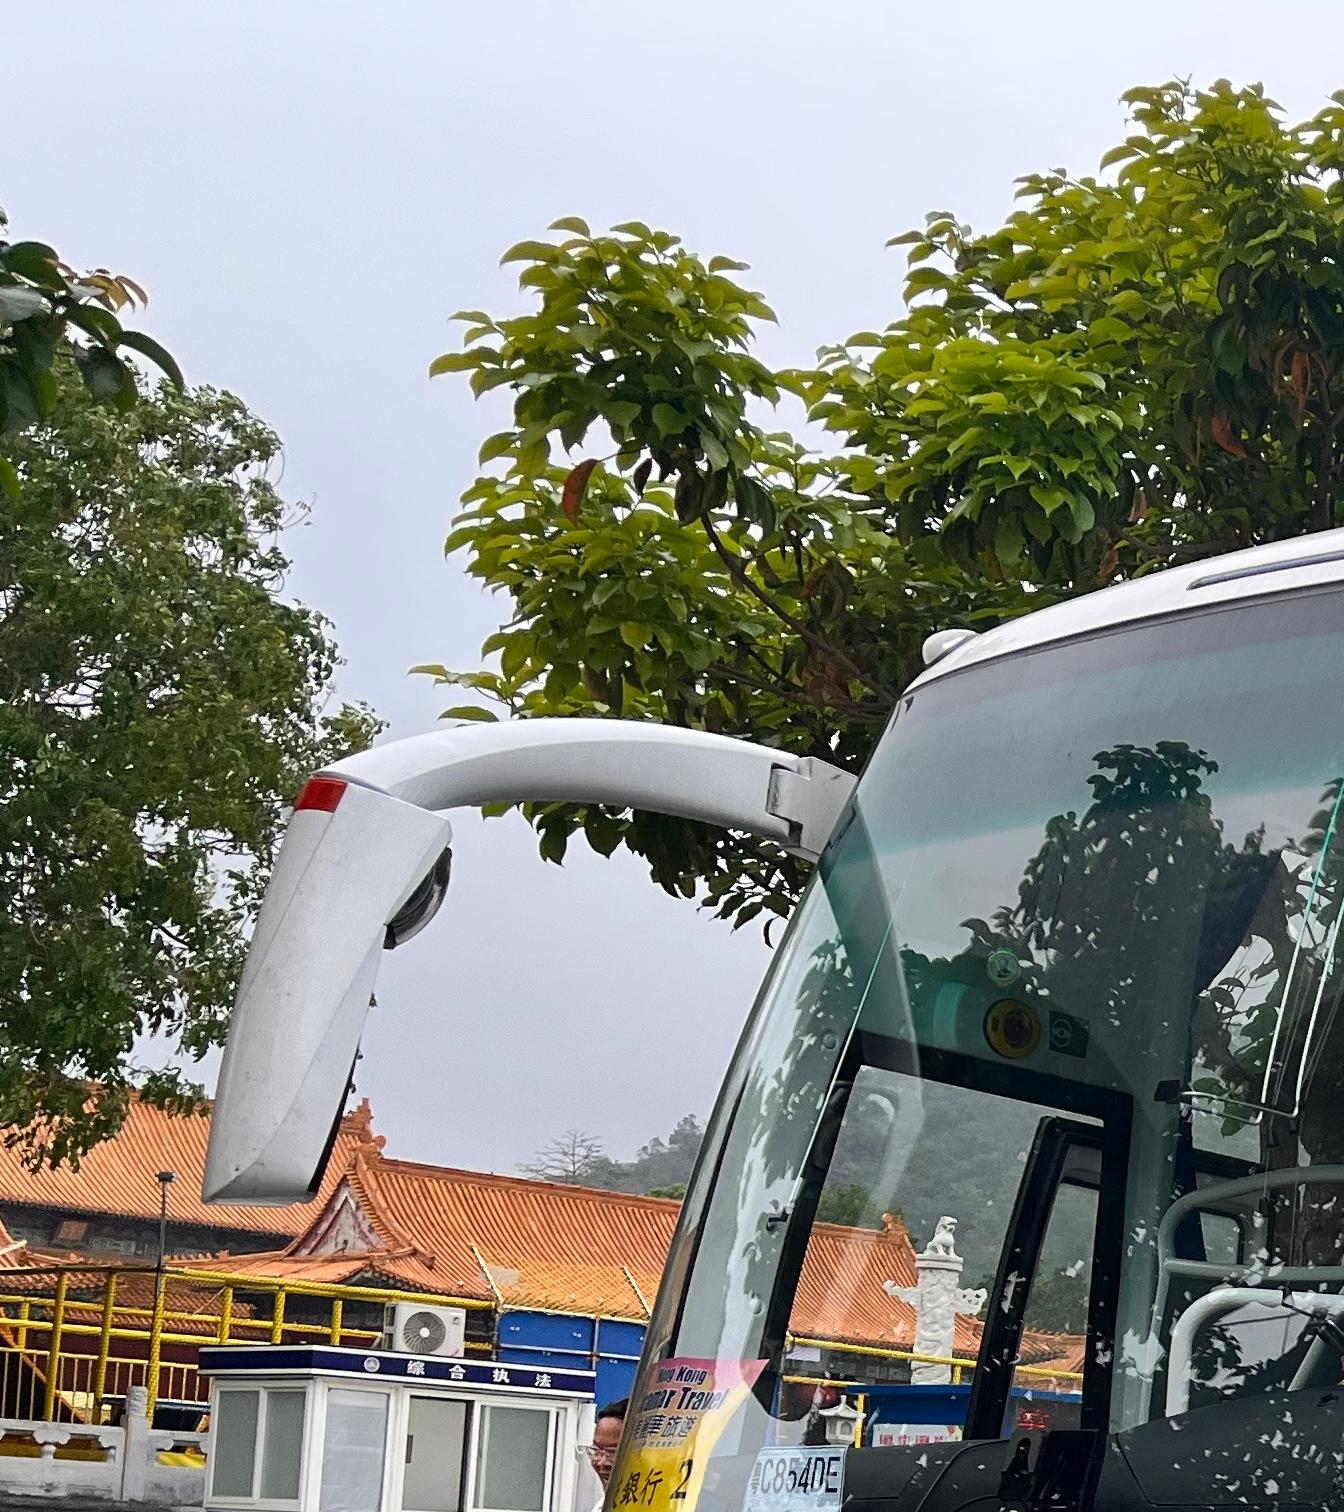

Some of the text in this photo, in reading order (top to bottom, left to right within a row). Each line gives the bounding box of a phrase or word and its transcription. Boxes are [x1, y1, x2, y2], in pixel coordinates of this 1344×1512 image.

[406, 1359, 553, 1388] 综合执法
[676, 1365, 708, 1386] Kong
[677, 1385, 731, 1411] Travel
[669, 1458, 693, 1500] 2
